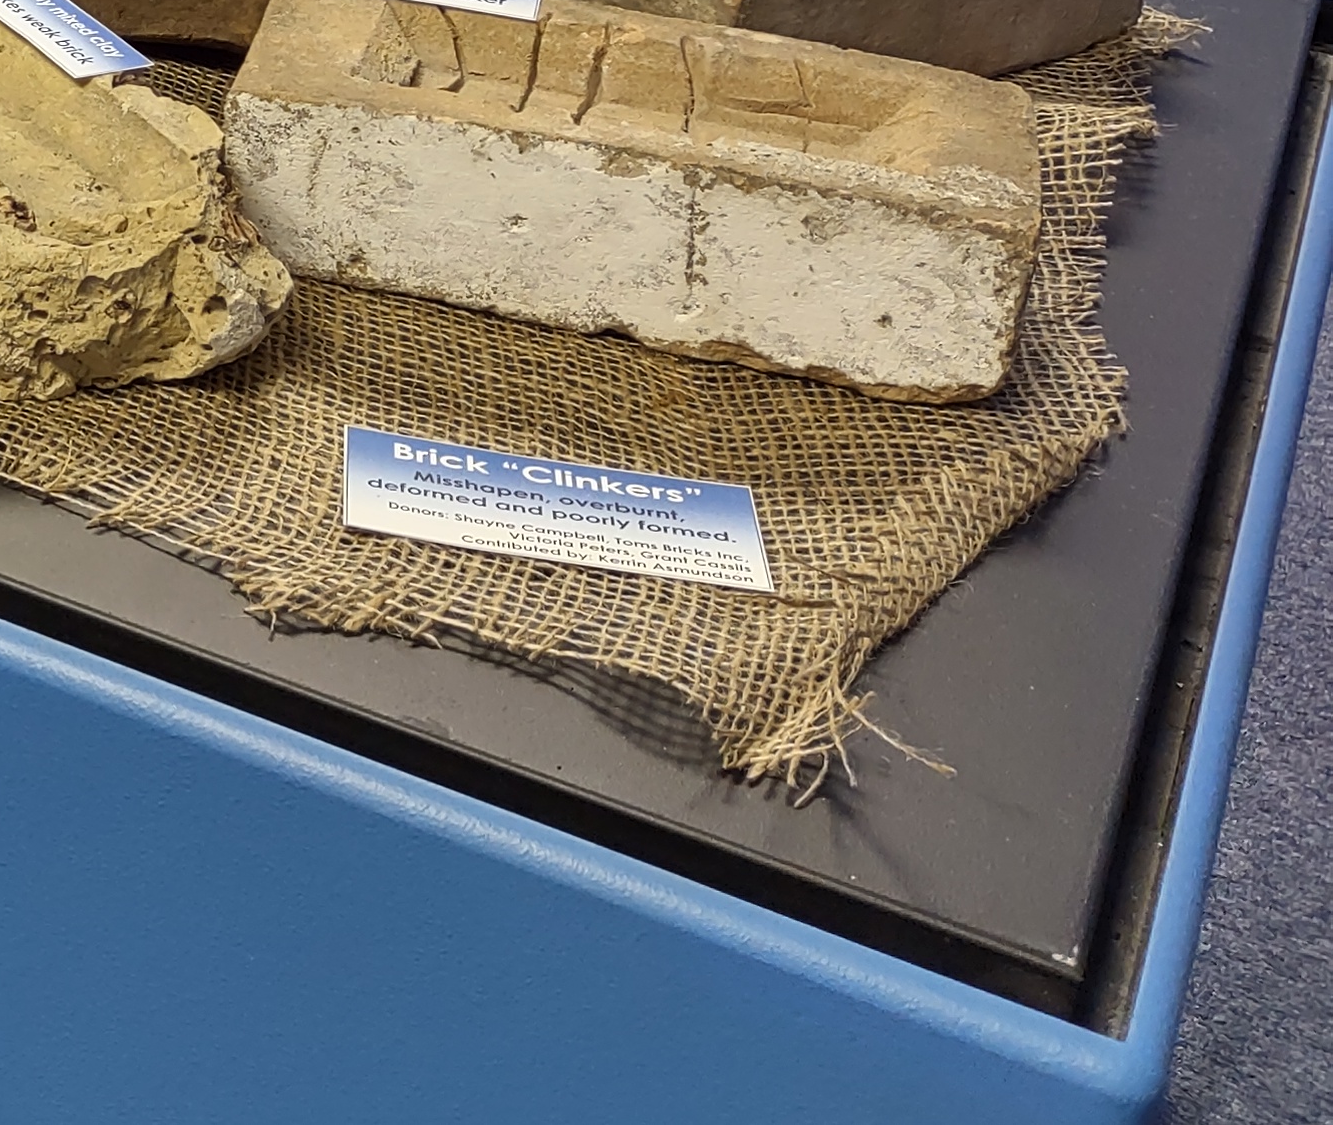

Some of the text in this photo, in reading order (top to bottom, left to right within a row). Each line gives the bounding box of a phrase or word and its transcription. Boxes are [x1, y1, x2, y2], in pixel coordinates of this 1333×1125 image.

[22, 13, 62, 39] weak
[55, 39, 95, 65] brick
[48, 7, 93, 36] mixed
[90, 35, 125, 59] clay
[392, 442, 702, 504] Brick “Clinkers”
[412, 470, 687, 524] Misshapen, overburnt,
[367, 477, 738, 545] deformed and poorly formed.
[388, 500, 449, 520] Donors:
[454, 512, 517, 532] Shayne
[521, 524, 610, 545] Campbell,
[614, 536, 658, 551] Toms
[662, 543, 713, 558] Bricks
[461, 534, 754, 585] Contributed by: Kerrin Asmundson
[509, 531, 753, 574] Victoria Peters, Grant Cassils
